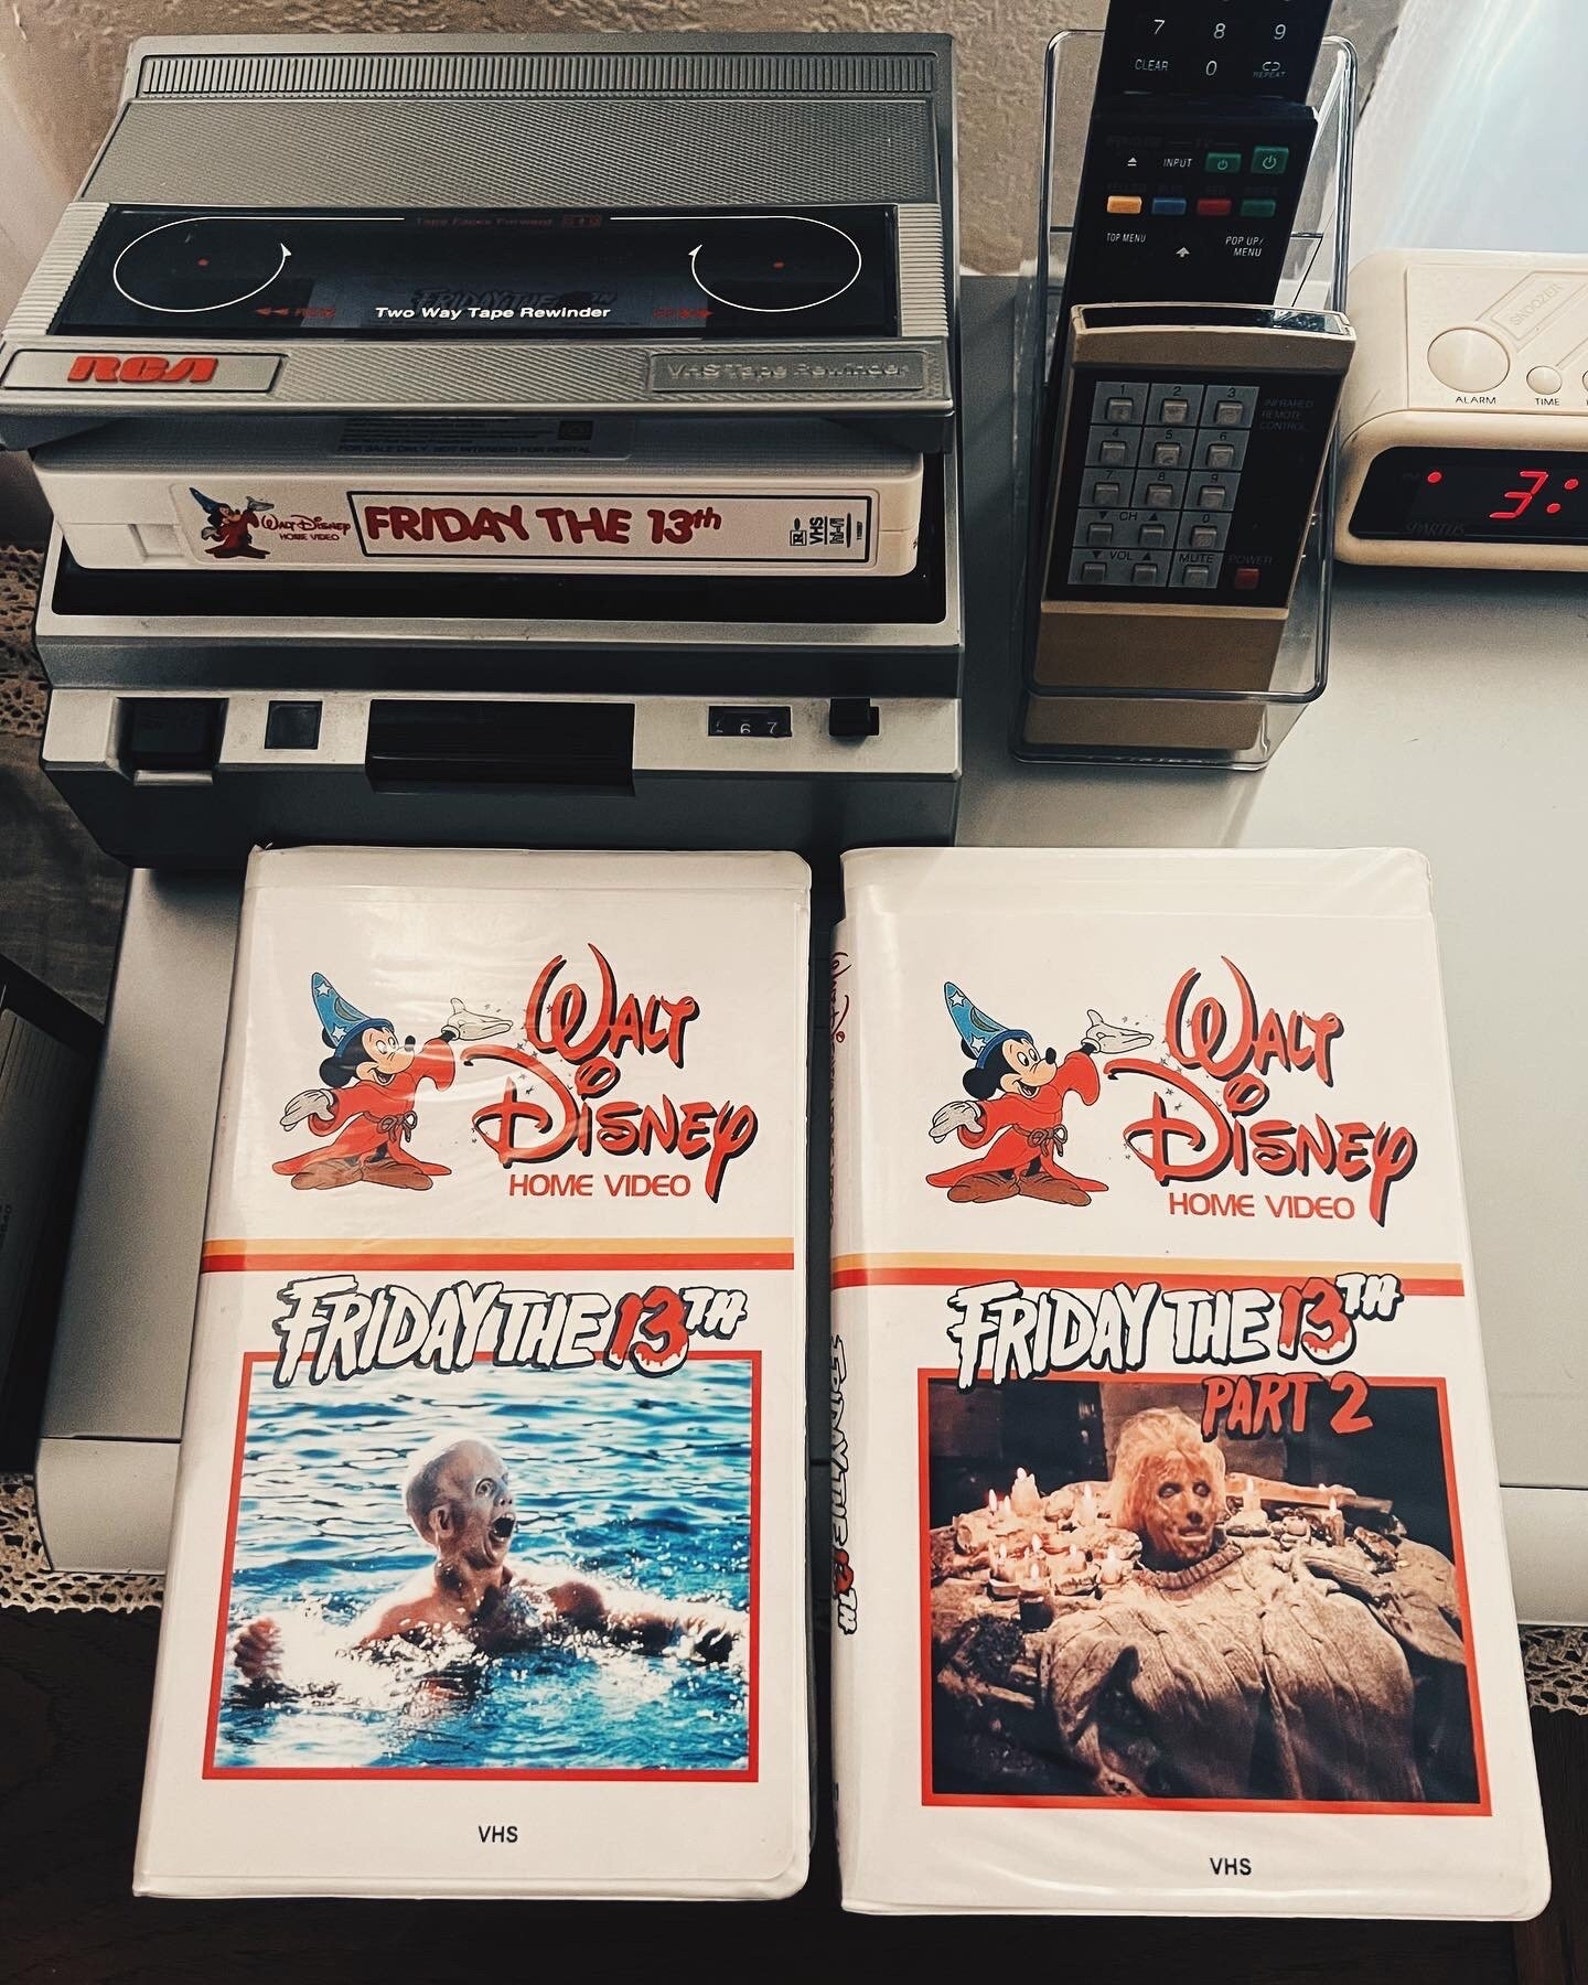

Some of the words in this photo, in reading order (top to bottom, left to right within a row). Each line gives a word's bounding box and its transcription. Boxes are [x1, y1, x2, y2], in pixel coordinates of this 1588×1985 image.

[1154, 19, 1166, 35] 7
[1214, 22, 1226, 40] 8
[1274, 24, 1286, 40] 9
[1135, 58, 1169, 72] CLEAR
[1162, 158, 1193, 168] INPUT
[1106, 232, 1121, 242] TOP
[1123, 232, 1147, 244] MENU
[1225, 236, 1244, 246] POP
[1246, 236, 1265, 246] UP/
[1232, 246, 1262, 258] MENU
[375, 306, 416, 319] Two
[418, 306, 462, 321] Way
[467, 306, 514, 321] Tape
[519, 306, 611, 320] Rewinder
[66, 355, 218, 384] RCA
[668, 364, 721, 379] VHS
[724, 363, 788, 382] Tape
[793, 362, 910, 378] Rewinder
[1120, 384, 1126, 395] 1
[1172, 386, 1181, 396] 2
[1228, 387, 1236, 398] 3
[1454, 396, 1498, 404] ALARM
[1534, 397, 1560, 406] TIME
[1112, 428, 1120, 438] 4
[1165, 430, 1173, 440] 5
[1219, 432, 1228, 442] 6
[1106, 471, 1114, 480] 7
[1157, 472, 1165, 482] 8
[1210, 473, 1218, 483] 9
[364, 504, 530, 543] FRIDAY
[536, 506, 633, 544] THE
[646, 506, 723, 545] 13th
[1119, 512, 1138, 522] CH
[1202, 514, 1210, 524] 0
[809, 516, 824, 545] VHS
[280, 534, 308, 542] HOME
[310, 534, 340, 542] VIDEO
[793, 532, 804, 545] R
[1110, 550, 1133, 560] VOL
[1178, 553, 1214, 564] MUTE
[1228, 554, 1274, 564] POWER
[508, 1173, 593, 1198] HOME
[603, 1174, 692, 1198] VIDEO
[1168, 1192, 1256, 1218] HOME
[1263, 1193, 1356, 1221] VIDEO
[272, 1274, 503, 1389] FRIDAY
[485, 1288, 614, 1372] THE
[946, 1277, 1164, 1395] FRIDAY
[1162, 1286, 1276, 1366] THE
[1201, 1372, 1324, 1442] PART
[1327, 1370, 1377, 1438] 2
[478, 1825, 519, 1844] VHS
[1209, 1857, 1253, 1876] VHS
